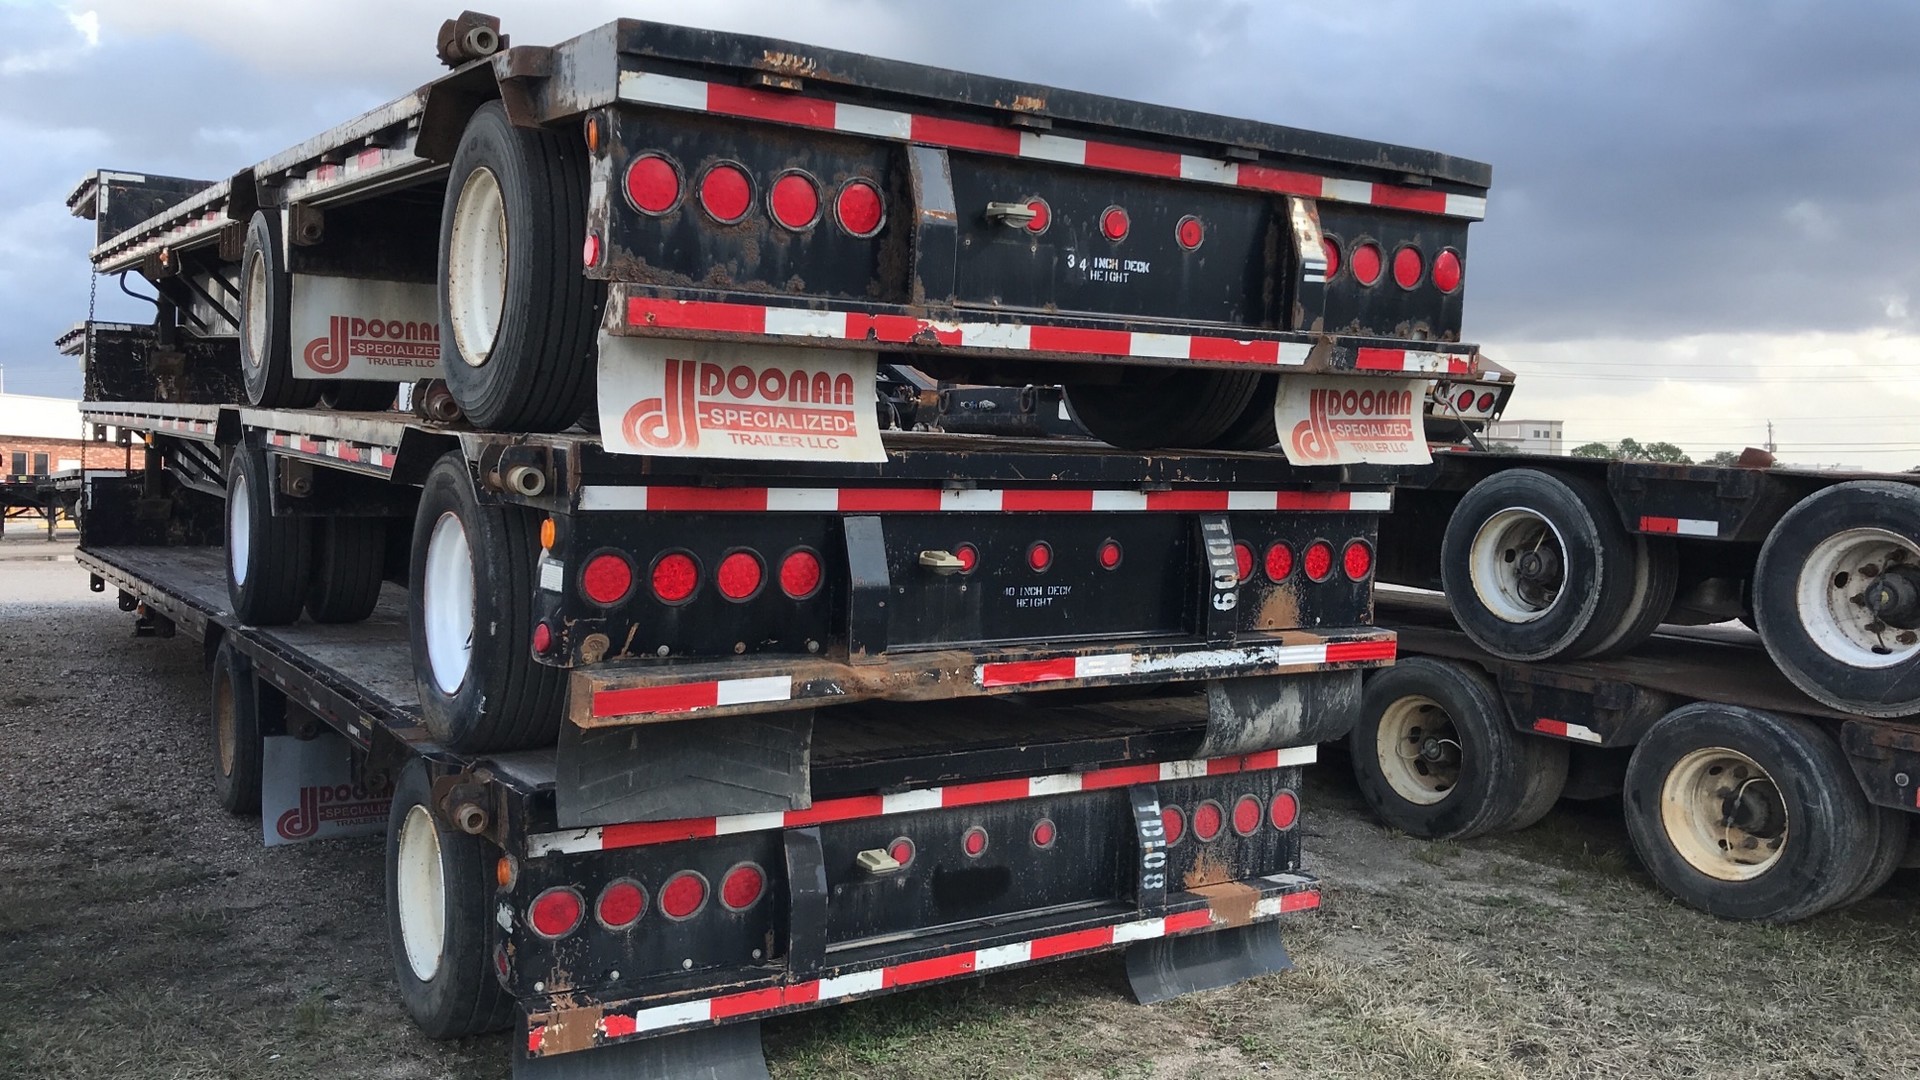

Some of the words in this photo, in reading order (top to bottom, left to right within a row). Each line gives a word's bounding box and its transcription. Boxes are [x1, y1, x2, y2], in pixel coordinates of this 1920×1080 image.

[1094, 257, 1118, 270] INCH
[1124, 259, 1150, 273] DECK
[1090, 269, 1129, 283] HEIGHT
[366, 357, 413, 367] TRAILER
[415, 359, 435, 368] LLC
[700, 362, 854, 405] DOONAN
[1328, 389, 1412, 416] DOONAN
[710, 408, 850, 432] SPECIALIZED
[1337, 422, 1409, 438] SPECIALIZED
[727, 432, 804, 448] TRAILER
[808, 437, 840, 450] LLC
[1351, 442, 1390, 454] TRAILER
[1391, 442, 1408, 454] LLC
[1020, 586, 1043, 596] INCH
[1047, 586, 1072, 595] DECK
[1016, 598, 1053, 608] HEIGHT
[325, 804, 389, 818] SPECIALIZ
[336, 816, 378, 827] TRAILER
[1138, 800, 1167, 890] TD108
